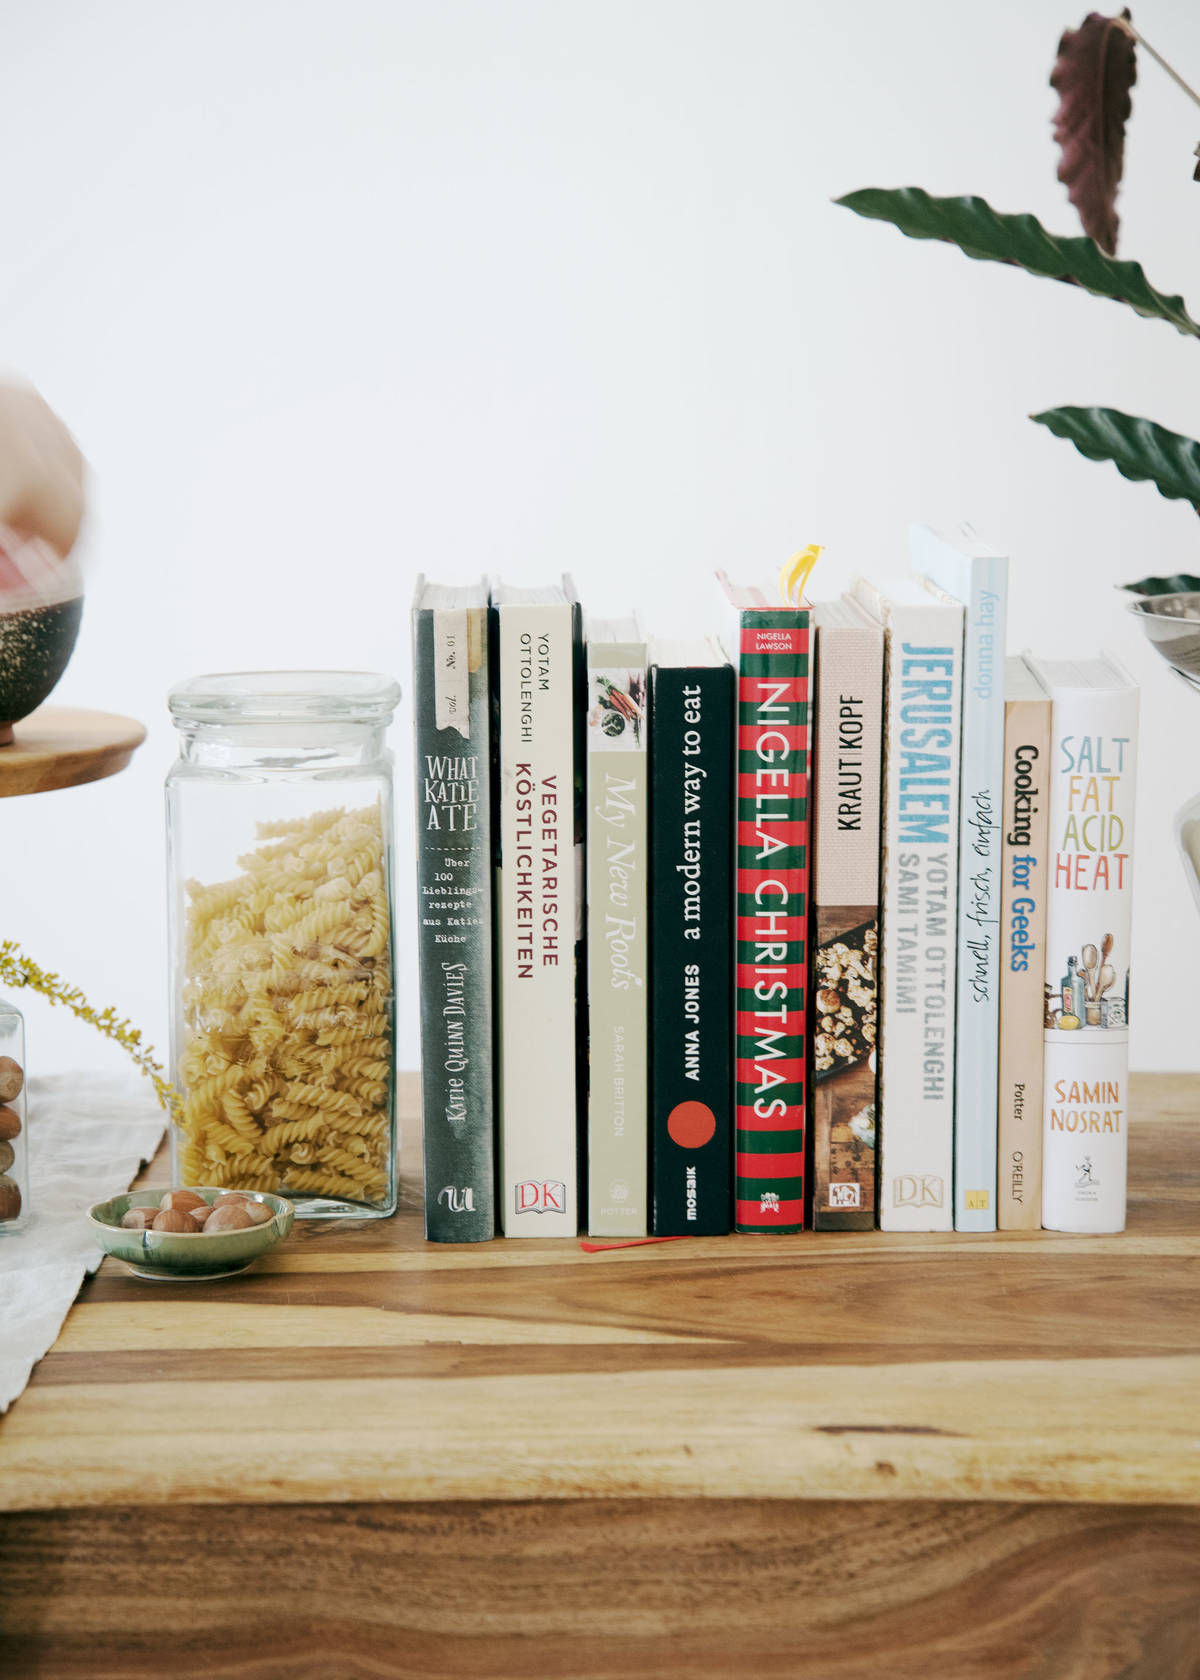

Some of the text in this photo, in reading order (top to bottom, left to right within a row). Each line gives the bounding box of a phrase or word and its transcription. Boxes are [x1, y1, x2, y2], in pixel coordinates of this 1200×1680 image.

[755, 642, 793, 651] LAWSON
[756, 632, 792, 641] NIGELLA
[972, 590, 998, 700] donna hay
[537, 633, 550, 691] YOTAM
[519, 633, 532, 743] OTTOLENGHI
[898, 642, 954, 844] JERUSALEM
[1060, 735, 1130, 774] SALT
[424, 755, 479, 780] WHAT
[676, 684, 708, 940] a modern way to eat
[1068, 775, 1121, 812] FAT
[426, 804, 478, 832] ATE
[967, 789, 1001, 857] einfach
[1062, 813, 1124, 852] ACID
[434, 872, 454, 881] 100
[515, 763, 536, 979] KÖSTLICHKEITEN
[541, 775, 559, 967] VEGETARISCHE
[1007, 745, 1039, 972] Cooking for Geeks
[1055, 852, 1129, 891] HEAT
[594, 773, 642, 991] My New Roots
[753, 682, 791, 1119] NIGELLA CHRISTMAS
[896, 853, 921, 915] SAMI
[423, 918, 442, 926] aus
[428, 900, 473, 911] rezepte
[922, 852, 949, 1101] YOTAM OTTOLENGHI
[684, 963, 700, 1082] ANNA JONES
[614, 1025, 625, 1137] SARAH BRITTON
[1054, 1079, 1120, 1105] SAMIN
[1013, 1082, 1026, 1121] Potter
[1051, 1108, 1124, 1134] NOSRAT
[519, 1182, 561, 1209] DK
[899, 1178, 941, 1202] DK
